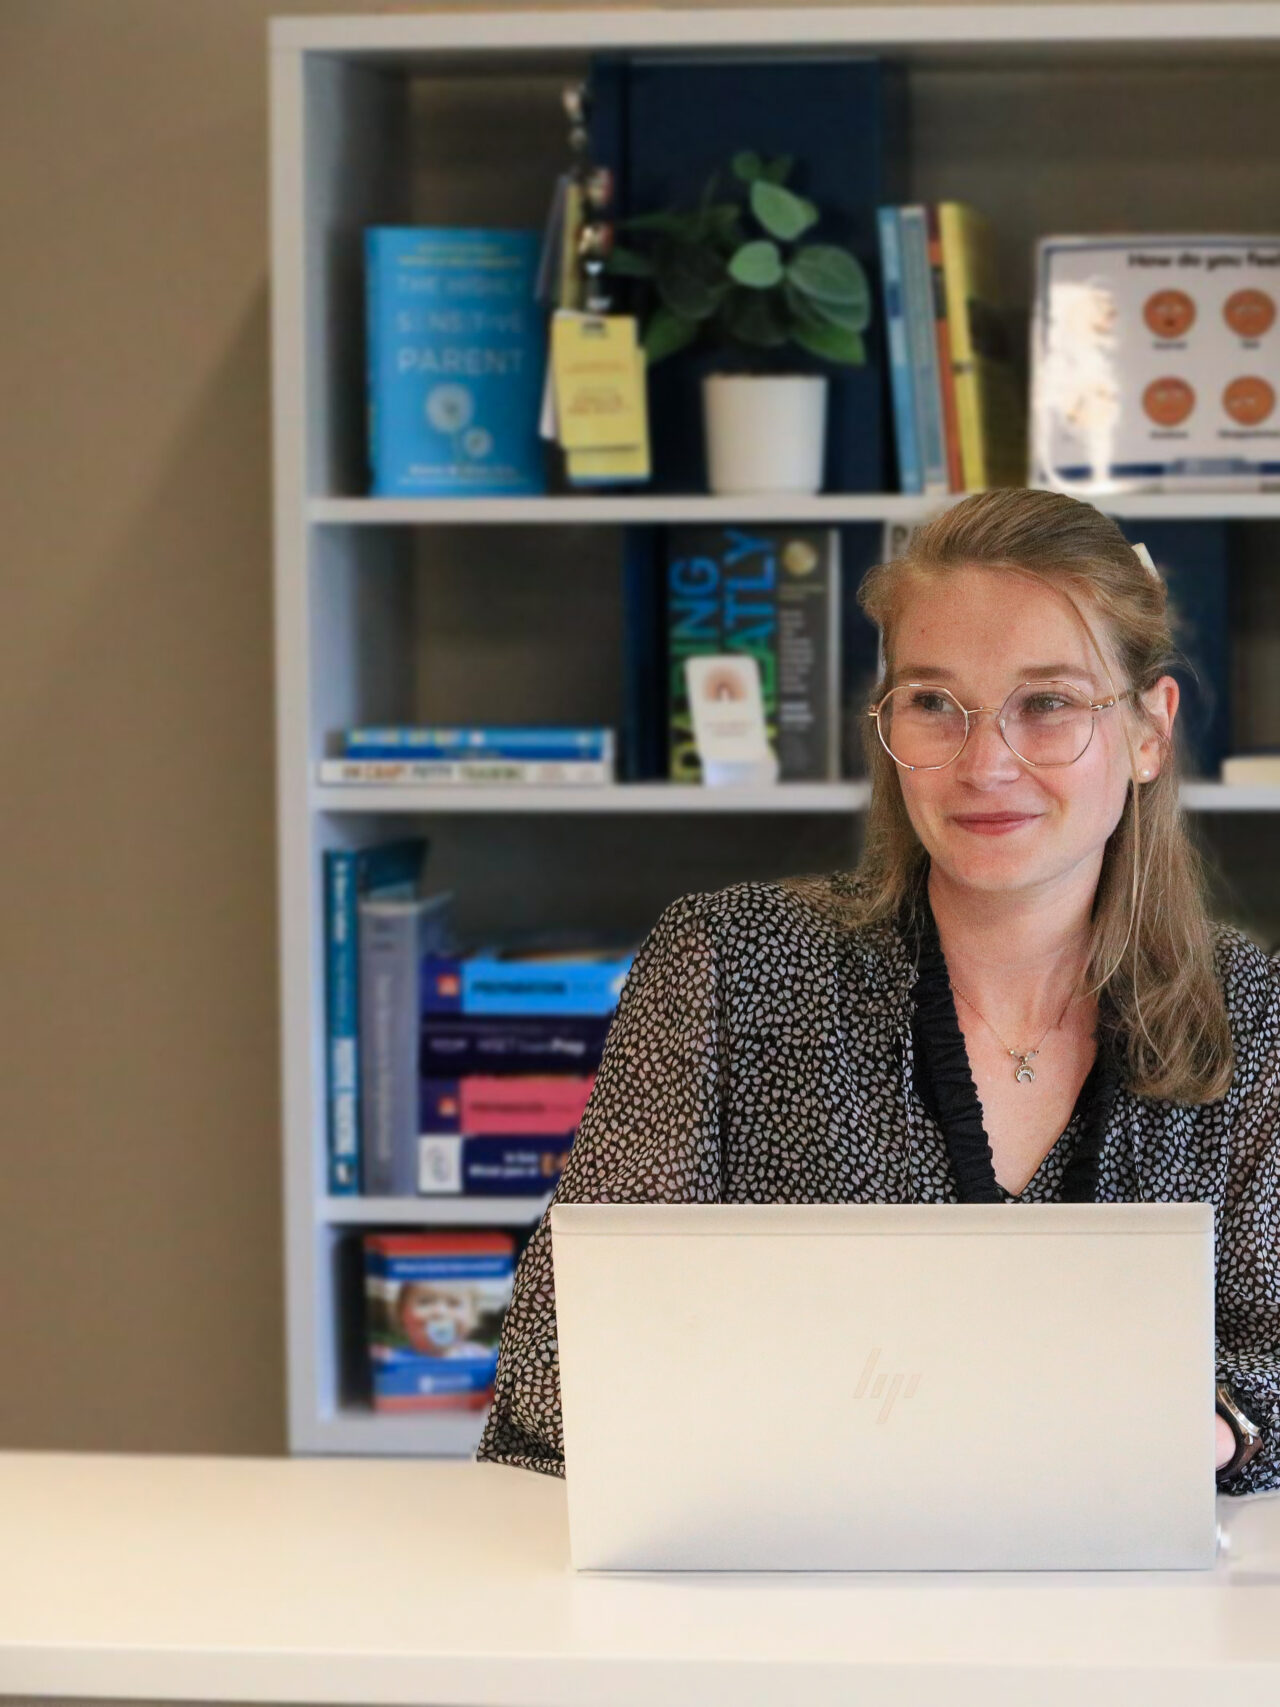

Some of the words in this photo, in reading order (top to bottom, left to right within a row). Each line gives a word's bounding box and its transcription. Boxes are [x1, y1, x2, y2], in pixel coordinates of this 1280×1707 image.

[1128, 252, 1172, 267] How
[1177, 252, 1201, 267] do
[1206, 255, 1241, 271] you
[397, 346, 526, 375] PARENT
